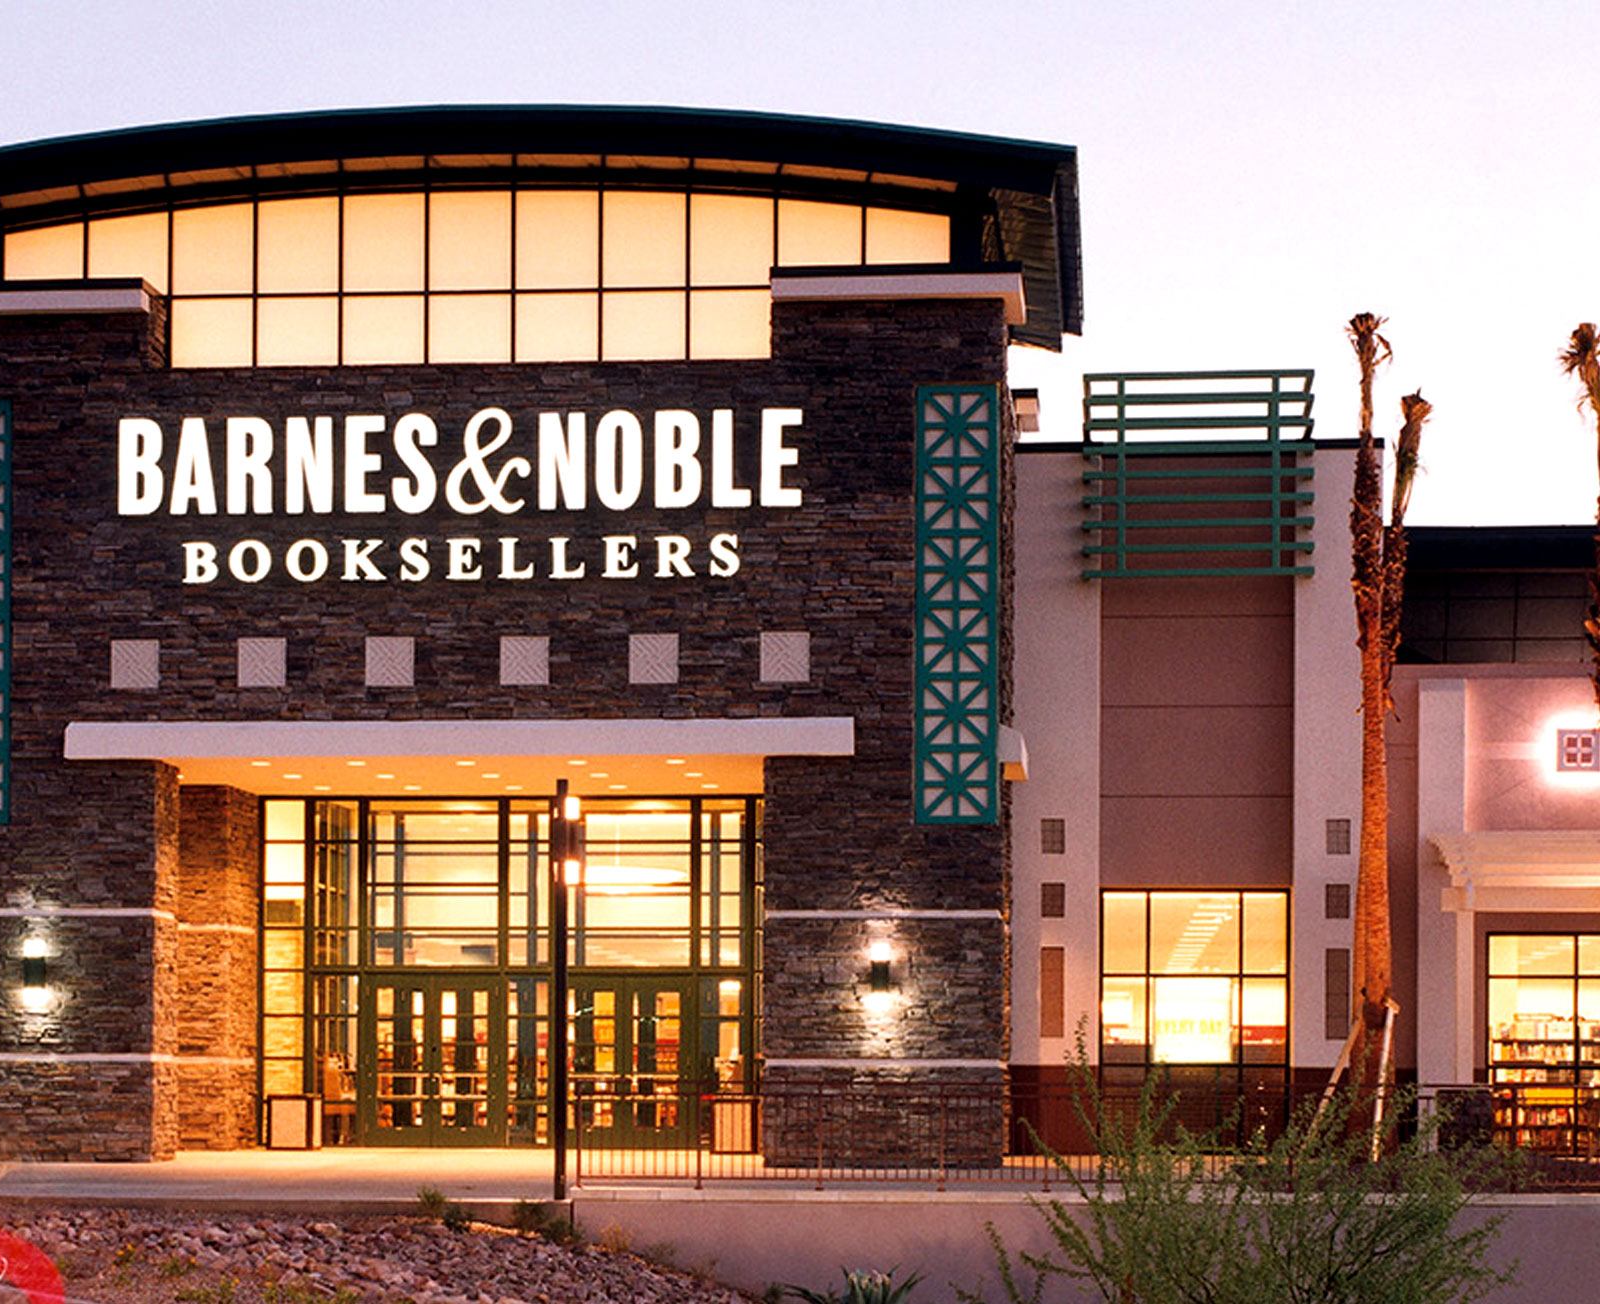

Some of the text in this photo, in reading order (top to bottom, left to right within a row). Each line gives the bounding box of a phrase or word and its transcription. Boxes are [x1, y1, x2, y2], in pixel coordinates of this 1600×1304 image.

[183, 533, 739, 583] BOOKSELLERS
[1155, 1019, 1195, 1035] EVERY
[1199, 1018, 1223, 1035] DAY
